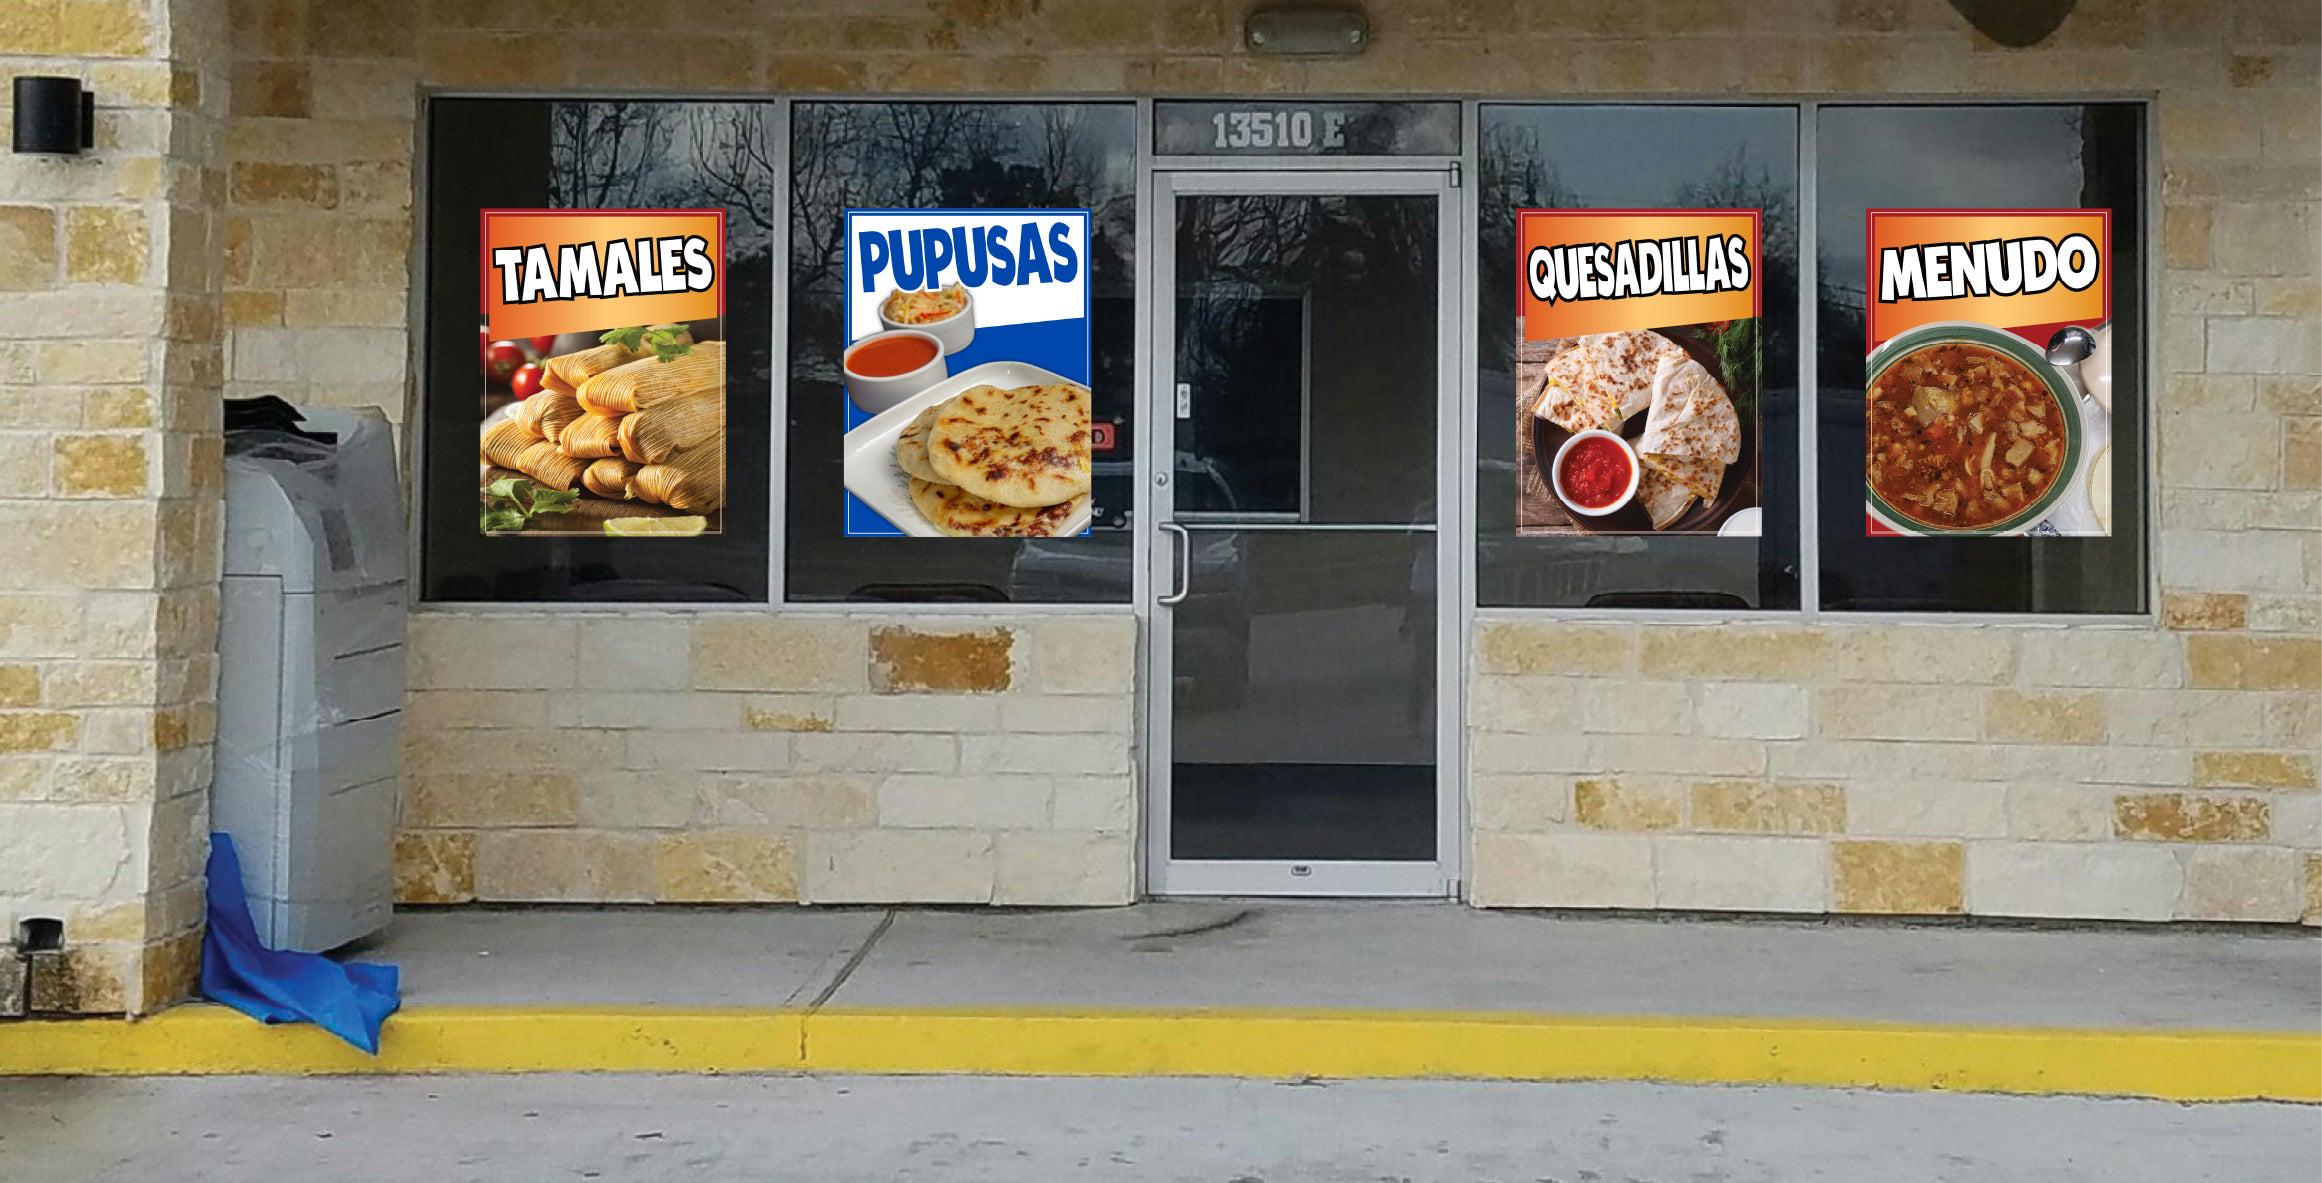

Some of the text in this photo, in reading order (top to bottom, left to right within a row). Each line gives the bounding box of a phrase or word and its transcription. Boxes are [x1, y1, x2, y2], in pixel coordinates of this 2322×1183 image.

[1213, 112, 1346, 148] 13510 E
[493, 235, 714, 304] TAMALES
[859, 222, 1078, 293] PUPUSAS
[1528, 234, 1751, 306] QUESADILLAS
[1879, 233, 2099, 304] MENUDO
